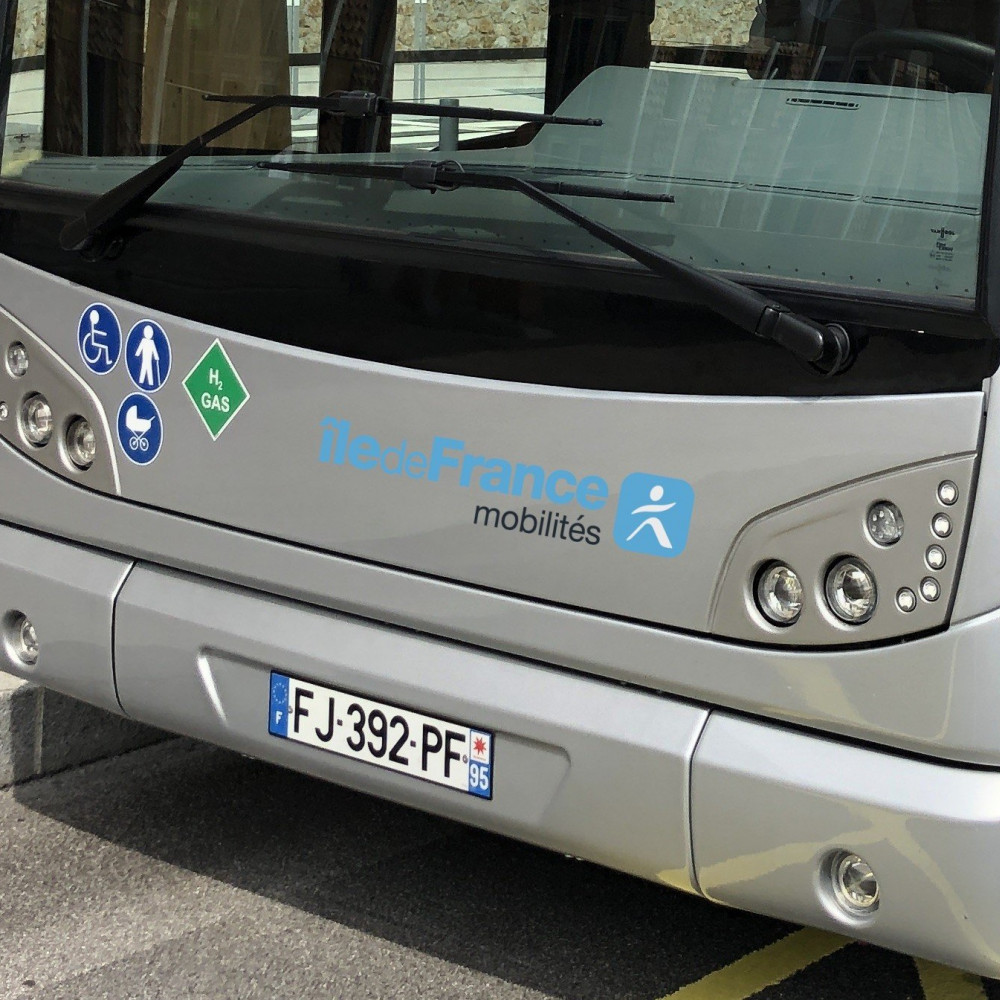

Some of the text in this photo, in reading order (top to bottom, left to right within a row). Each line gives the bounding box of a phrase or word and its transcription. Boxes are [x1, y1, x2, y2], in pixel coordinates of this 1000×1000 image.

[201, 392, 230, 413] GAS
[473, 504, 601, 546] mobilités
[275, 711, 283, 725] F
[469, 763, 489, 791] 95
